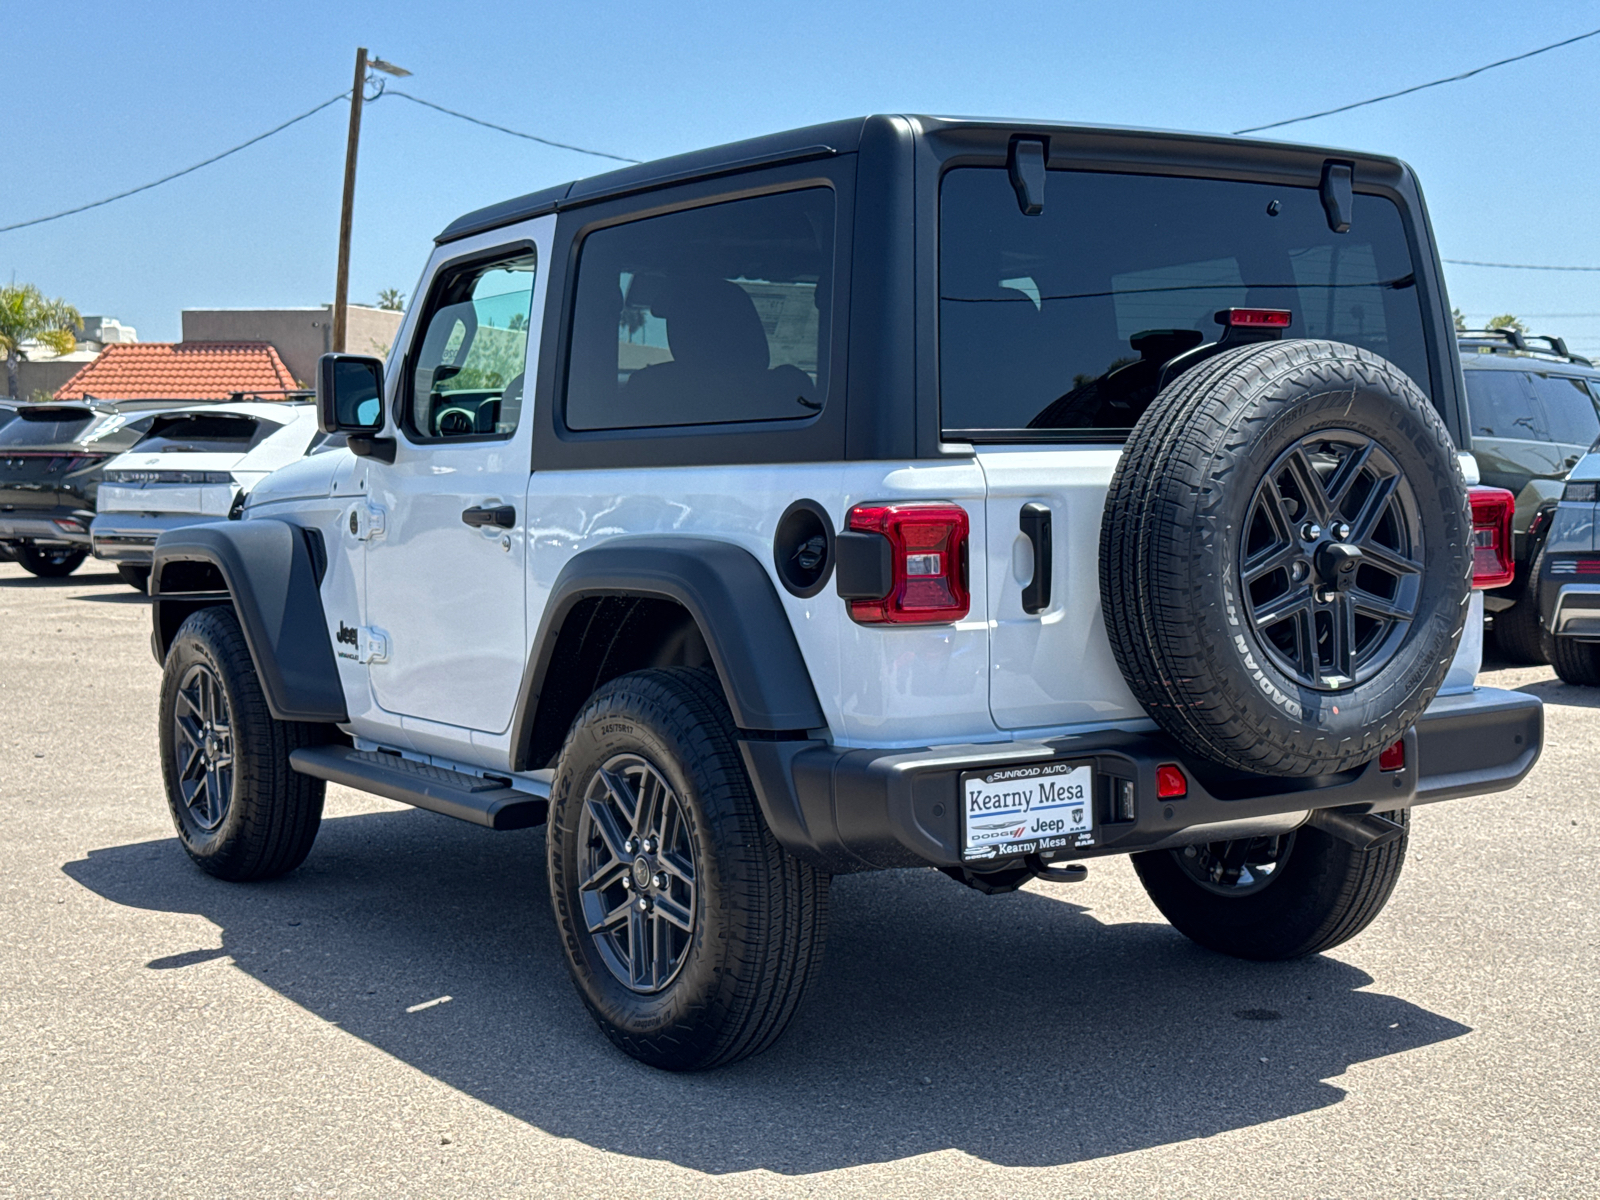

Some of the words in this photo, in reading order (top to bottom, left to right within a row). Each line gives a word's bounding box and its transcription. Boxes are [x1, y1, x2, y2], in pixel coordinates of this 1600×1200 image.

[1262, 403, 1310, 448] 245/75R17
[1397, 415, 1457, 539] NEXEN
[337, 650, 359, 661] WRANGLE
[601, 723, 634, 736] 245/75R17
[993, 767, 1040, 780] SUNROAD
[1042, 764, 1067, 775] AUTO
[969, 789, 1033, 813] Kearny
[1038, 782, 1084, 804] Mesa
[1031, 818, 1065, 833] Jeep
[971, 830, 1017, 841] DODGE
[1074, 838, 1096, 848] RAM
[1077, 832, 1092, 840] Jeep
[998, 841, 1037, 855] Kearny
[1039, 837, 1067, 849] Mesa
[553, 852, 584, 967] ROADIAN
